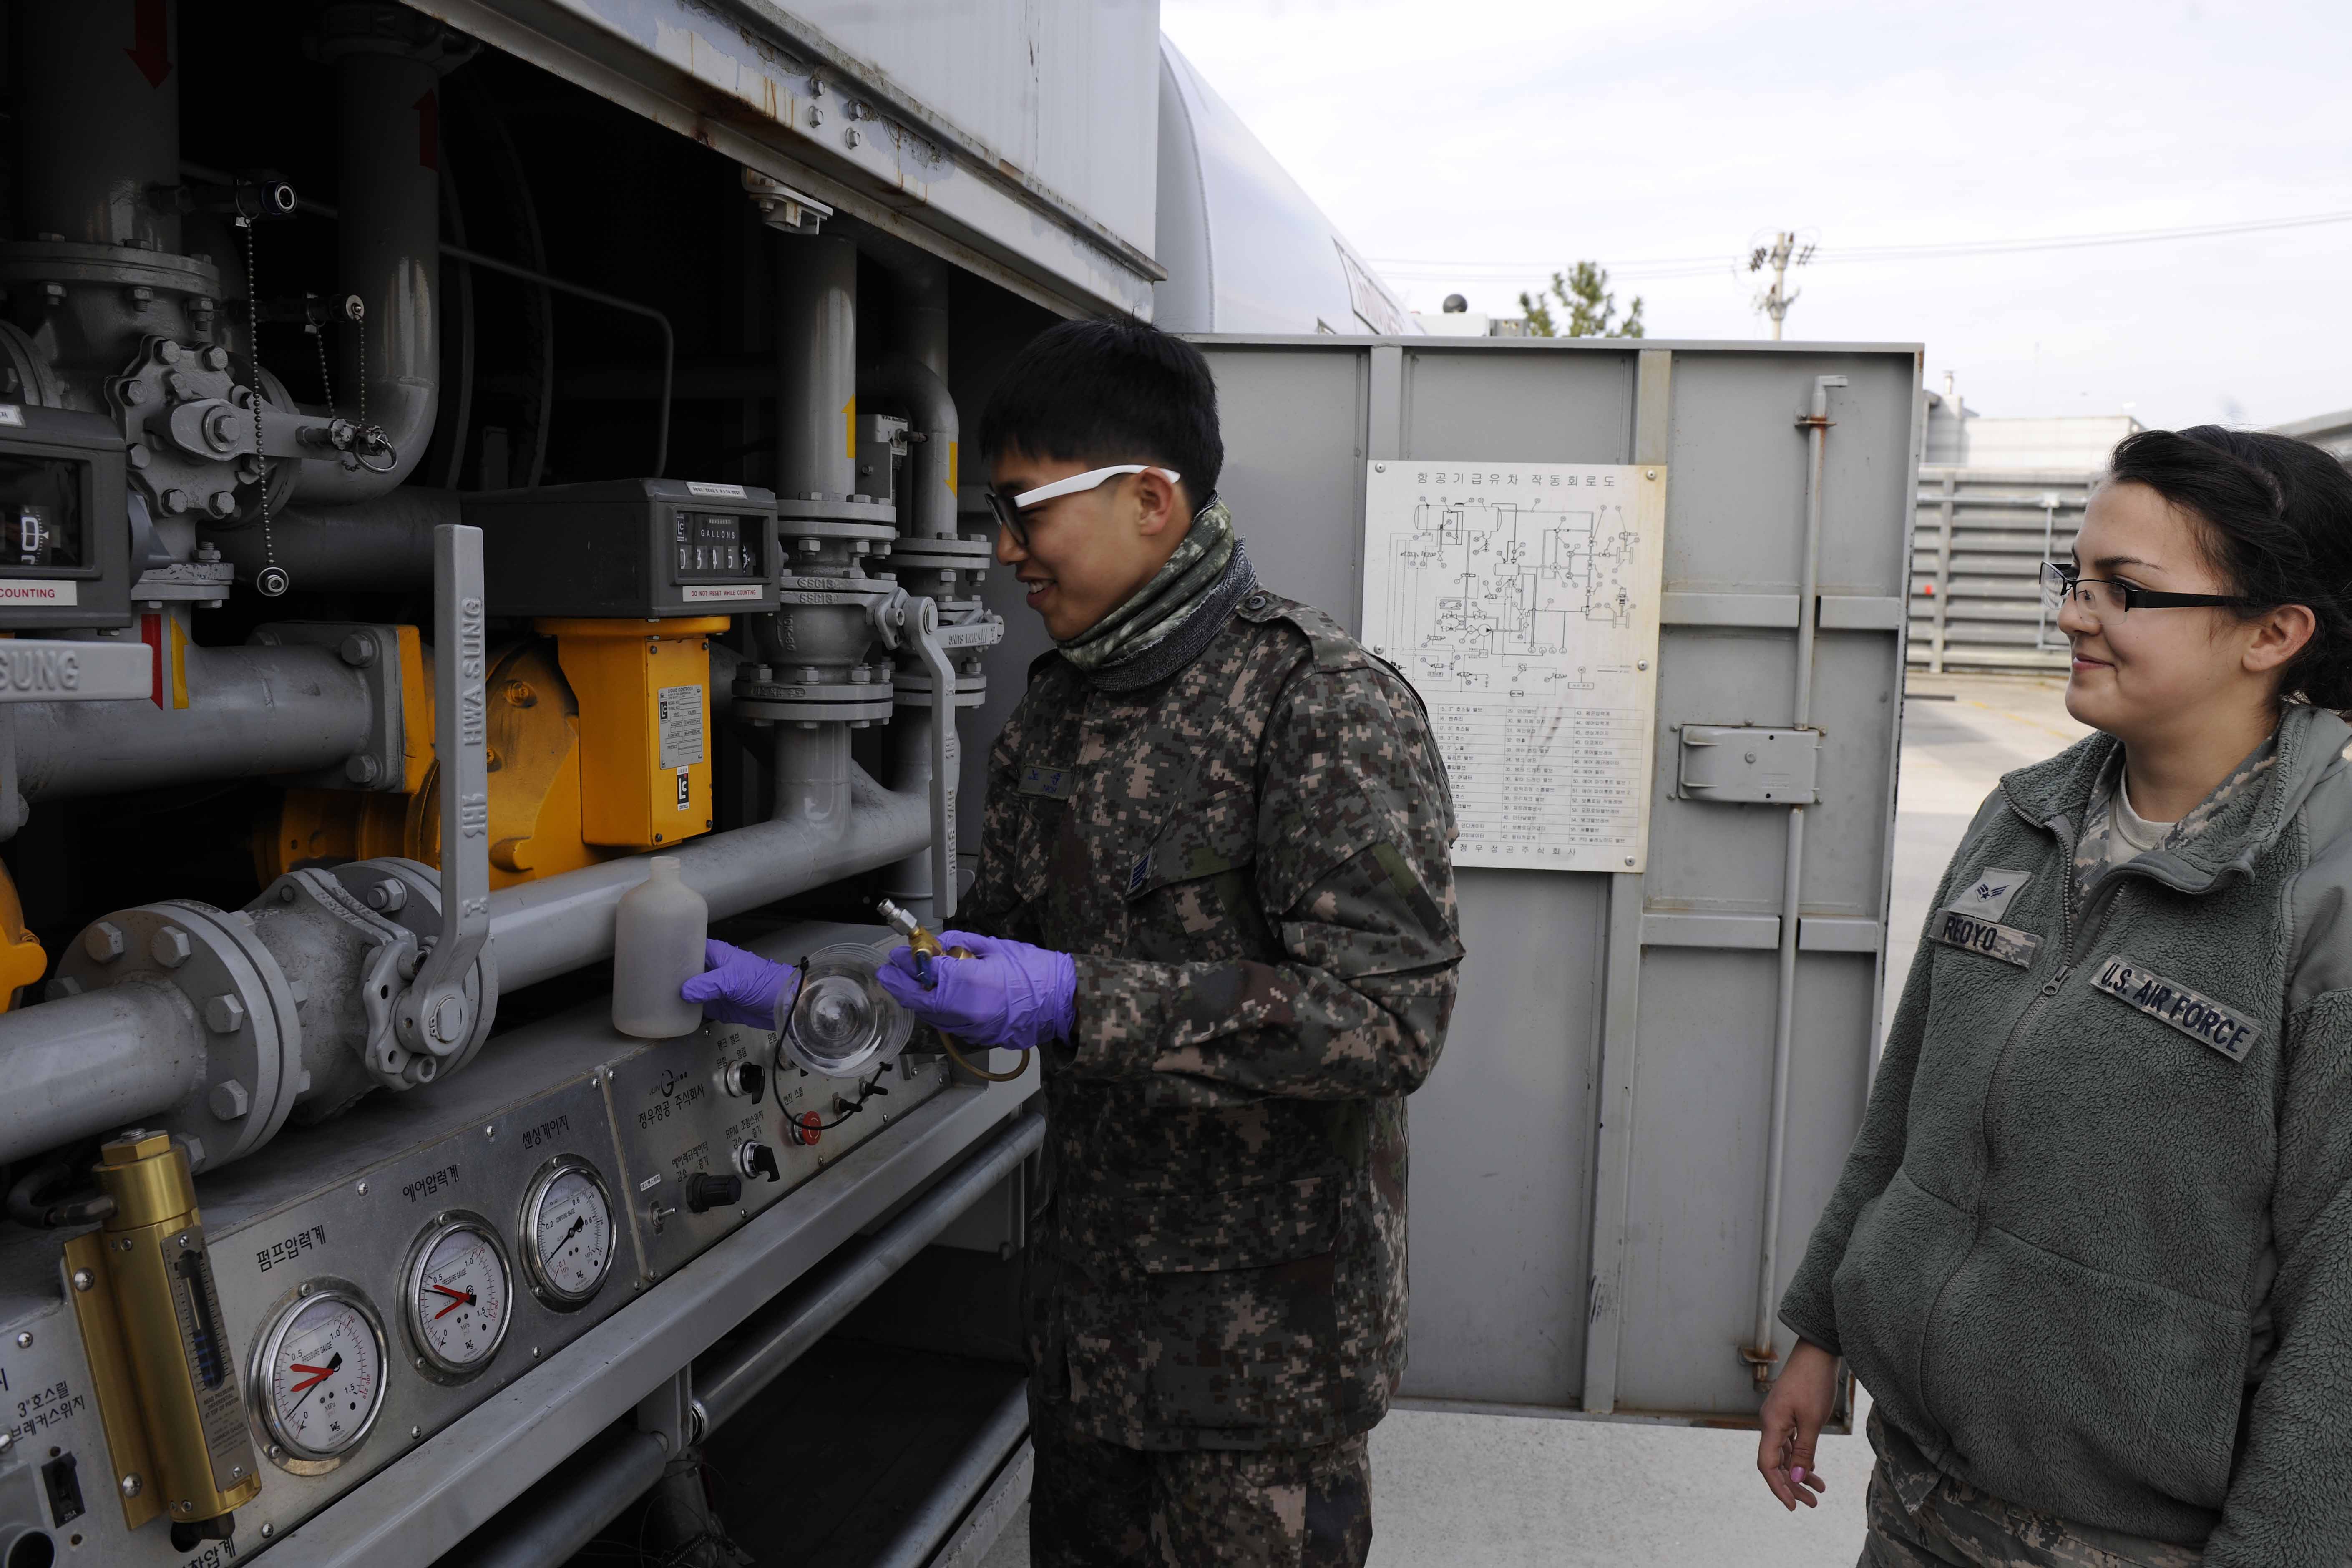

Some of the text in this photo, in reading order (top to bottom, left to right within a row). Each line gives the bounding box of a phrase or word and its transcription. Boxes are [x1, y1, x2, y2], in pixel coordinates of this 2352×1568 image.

[1418, 473, 1615, 487] 항공기급유차 작동회로도
[701, 529, 735, 539] GALLONS
[462, 597, 483, 747] HWA SUNG
[2101, 963, 2250, 1053] U.S. AIR FORCE
[783, 1092, 793, 1105] 엔진
[639, 1083, 704, 1129] 정우정공 주식회사
[522, 1115, 569, 1150] 센싱게이지
[725, 1125, 739, 1139] RPM
[732, 1125, 762, 1149] 감소 증가
[677, 1156, 709, 1183] 감소 증가
[402, 1164, 460, 1203] 에어압력계
[546, 1221, 554, 1230] 0.2
[256, 1224, 327, 1272] 펌프압력계
[465, 1257, 473, 1267] 1.0
[433, 1274, 443, 1284] 0.5
[477, 1307, 485, 1316] 1.5
[330, 1329, 340, 1341] 1.0
[291, 1349, 303, 1361] 0.5
[301, 1341, 332, 1363] PRESSURE GAUGE
[345, 1383, 355, 1394] 1.5
